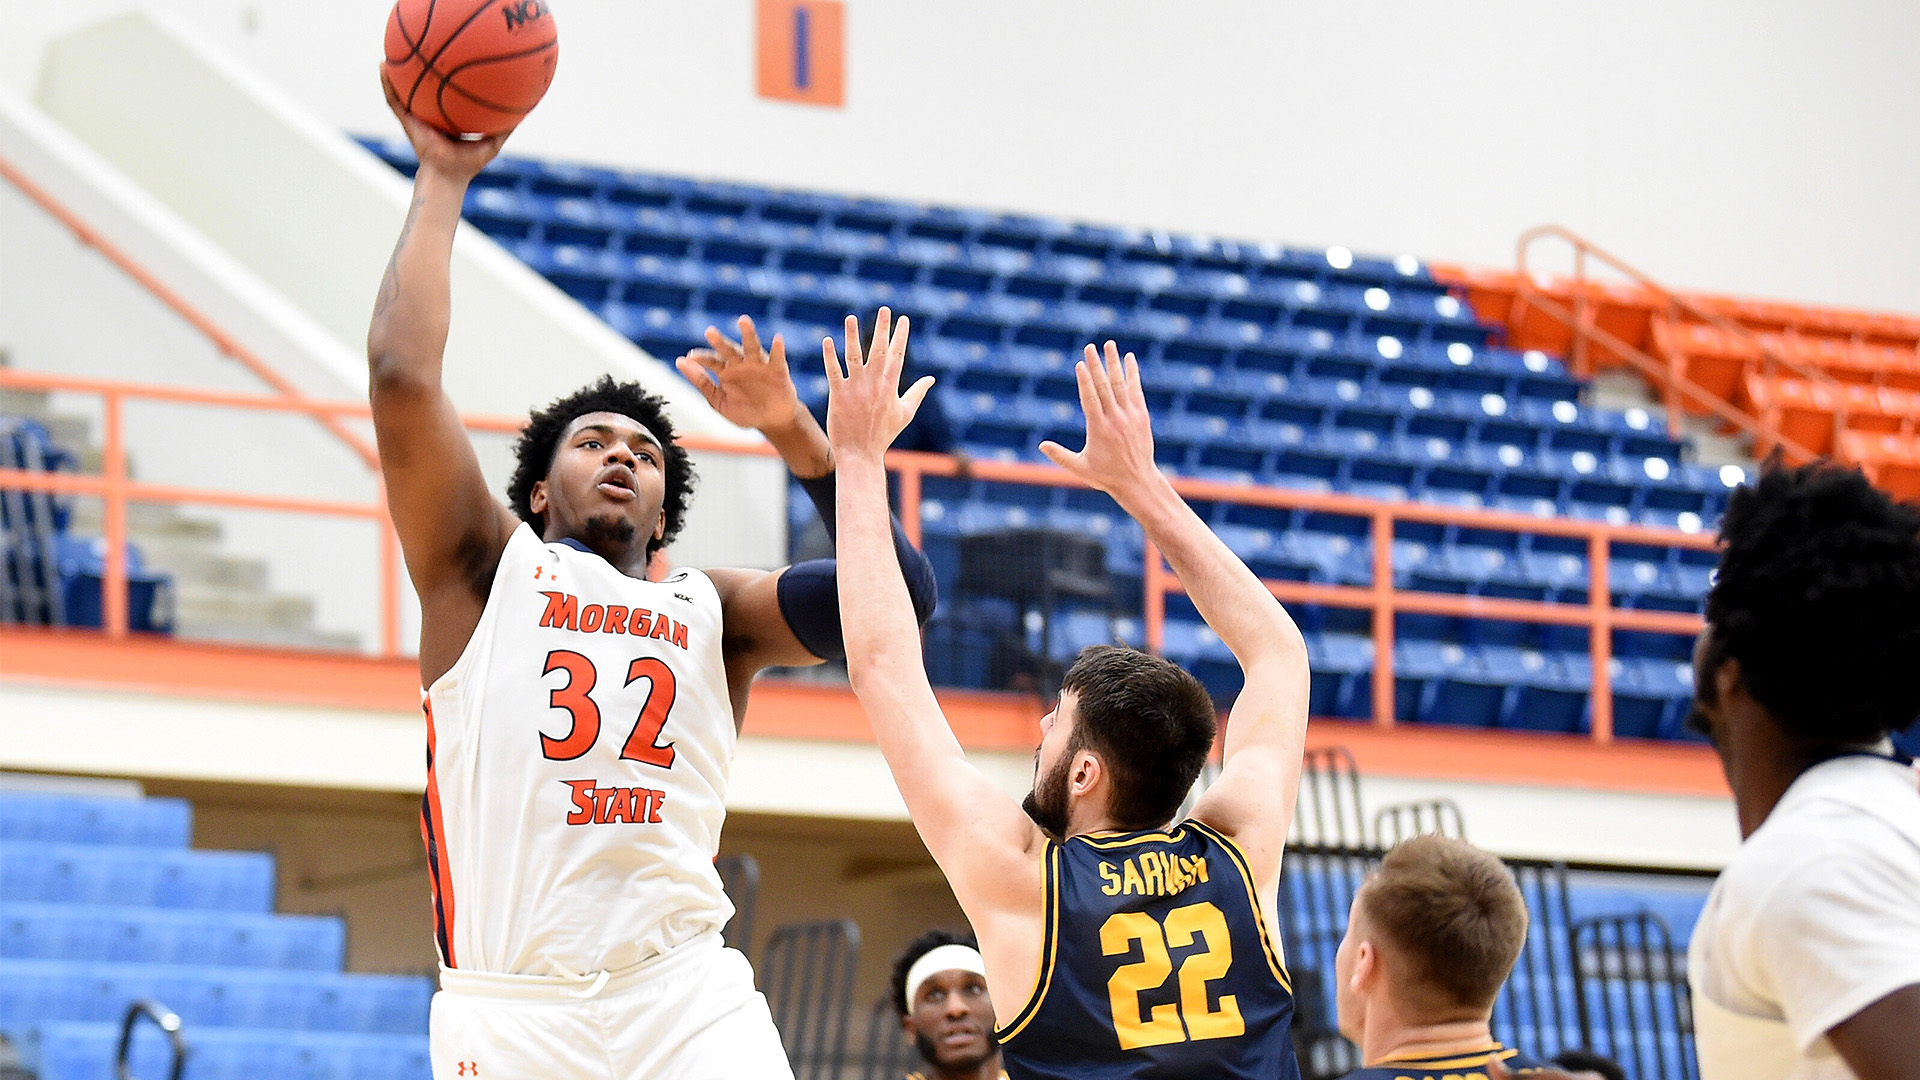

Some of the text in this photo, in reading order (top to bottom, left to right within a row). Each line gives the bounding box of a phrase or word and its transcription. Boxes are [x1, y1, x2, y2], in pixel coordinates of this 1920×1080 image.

[538, 649, 676, 769] 32
[558, 779, 665, 825] STATE
[1099, 901, 1246, 1051] 22
